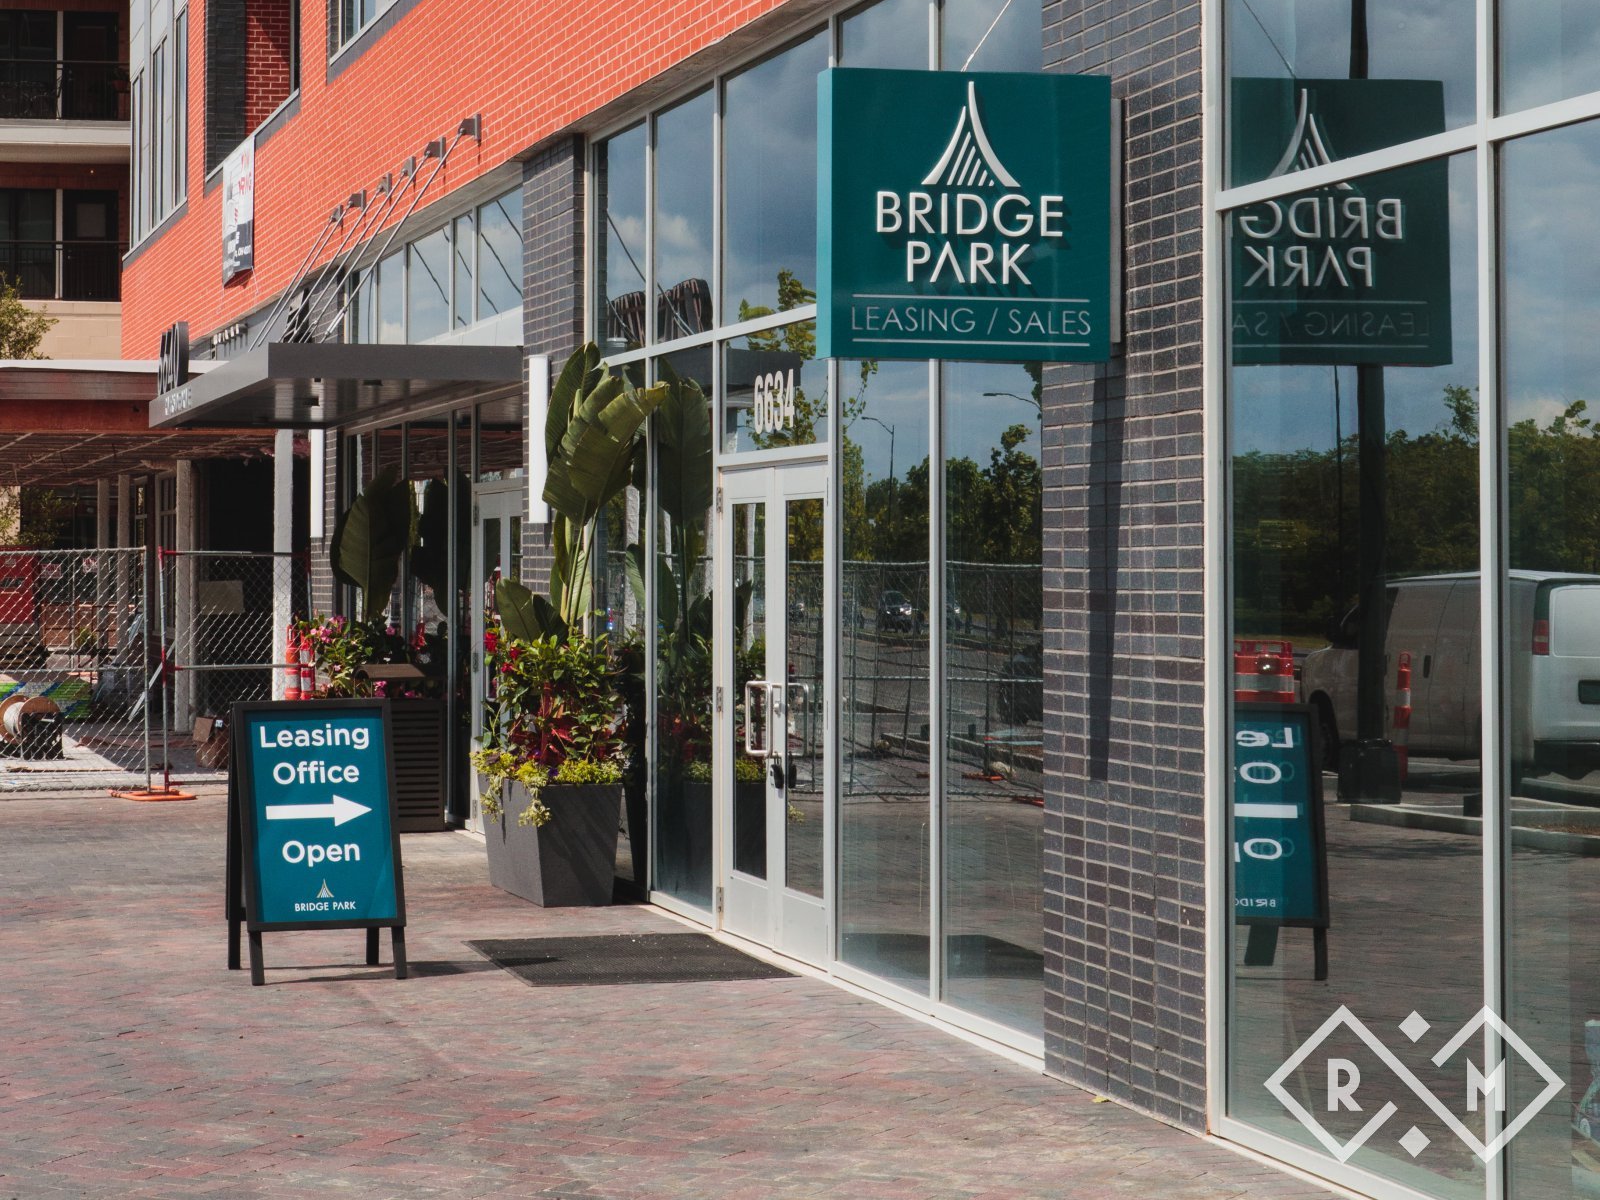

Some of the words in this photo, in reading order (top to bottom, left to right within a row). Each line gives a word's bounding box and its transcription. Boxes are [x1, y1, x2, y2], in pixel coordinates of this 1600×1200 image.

[876, 190, 1064, 237] BRIDGE
[907, 240, 1032, 285] PARK
[851, 305, 976, 333] LEASING
[1008, 309, 1092, 336] SALES
[754, 368, 795, 435] 6634
[259, 723, 370, 750] Leasing
[272, 760, 360, 785] Office
[282, 840, 360, 868] Open
[294, 902, 330, 912] BRIDGE
[332, 900, 357, 911] PARK
